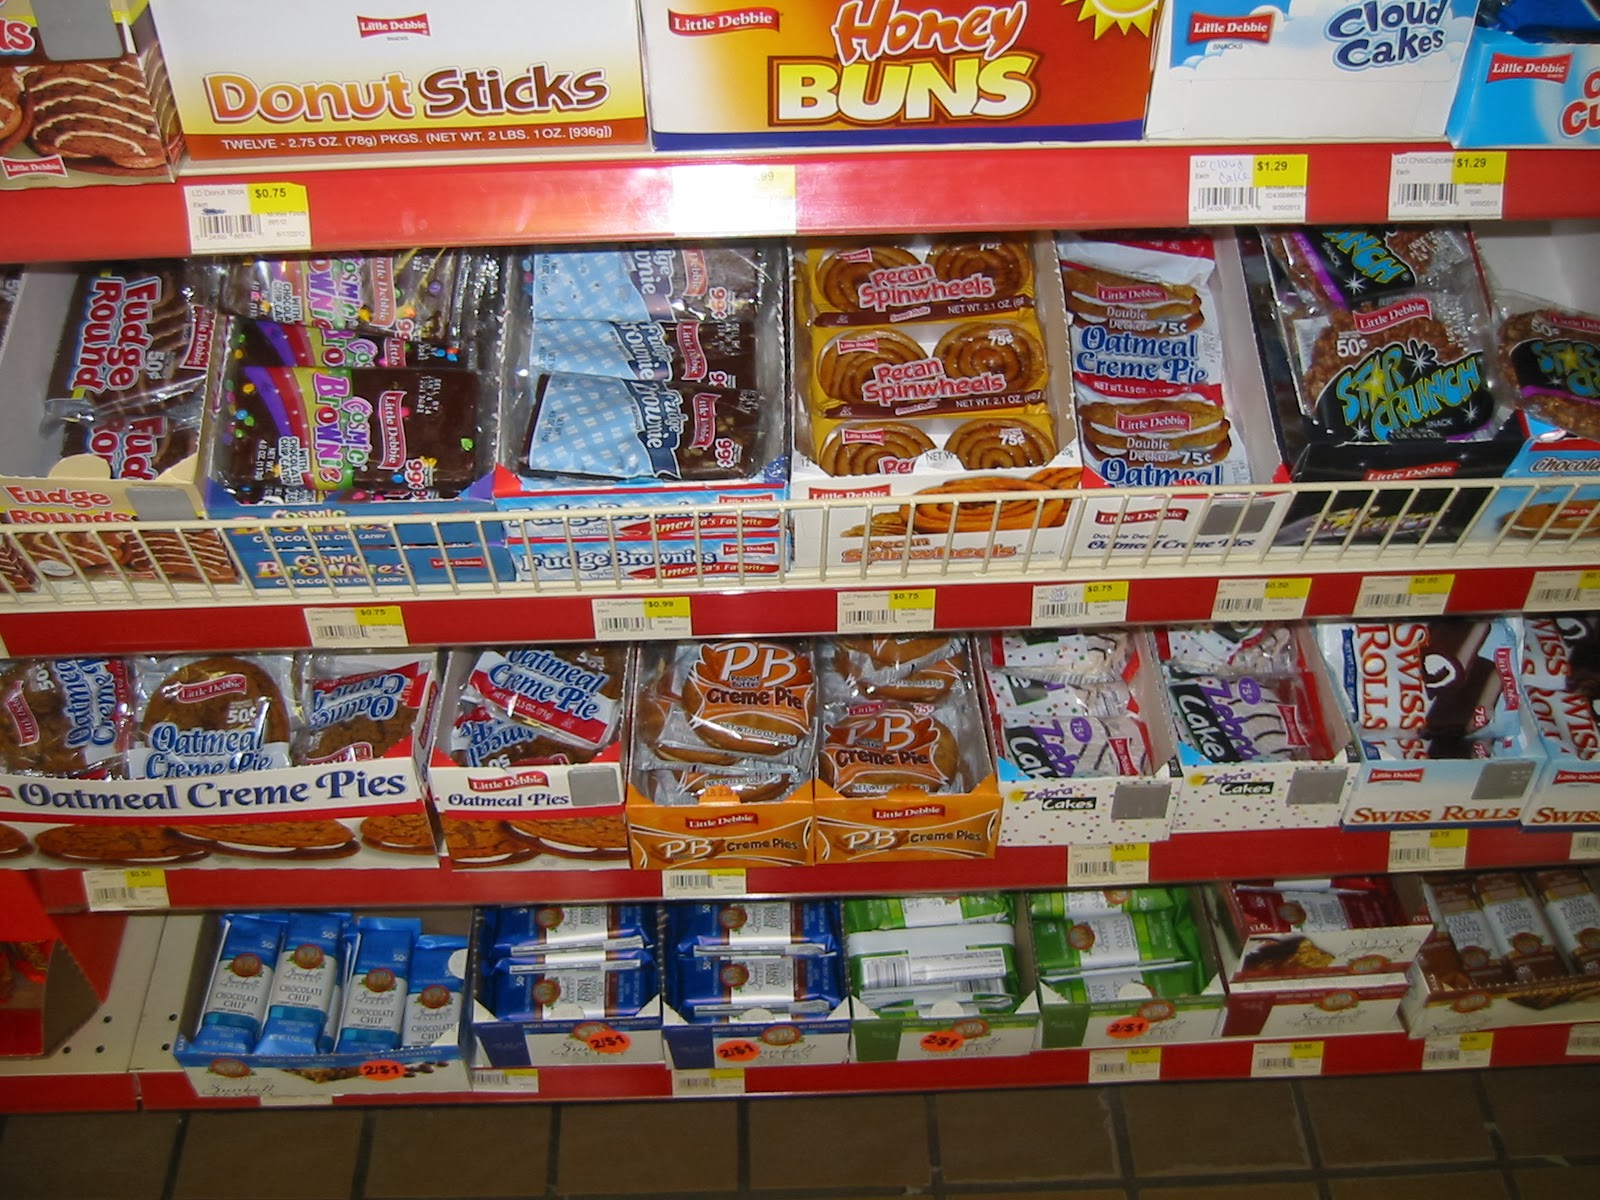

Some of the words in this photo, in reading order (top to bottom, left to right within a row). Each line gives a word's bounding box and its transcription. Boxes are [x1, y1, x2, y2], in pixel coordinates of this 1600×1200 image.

[360, 20, 389, 31] Little
[390, 19, 427, 31] Debbie
[674, 15, 716, 31] Little
[719, 11, 774, 28] Debbie
[1192, 22, 1223, 34] Little
[1226, 21, 1269, 34] Debbie
[1325, 0, 1445, 41] Cloud
[832, 0, 1028, 66] Honey
[1334, 25, 1445, 71] Cakes
[1492, 62, 1529, 75] Little
[1532, 62, 1567, 75] Debbie
[203, 71, 416, 124] Donut
[418, 62, 611, 120] Sticks
[772, 54, 1040, 125] BUNS
[221, 139, 277, 151] TWELVE
[288, 138, 316, 149] 2.75
[318, 137, 342, 148] OZ.
[345, 135, 377, 149] (78g)
[380, 132, 423, 145] PKGS.
[425, 131, 458, 145] (NET
[460, 131, 486, 143] WT.
[488, 130, 497, 141] 2
[500, 129, 531, 141] LBS.
[541, 128, 566, 139] OZ.
[1256, 160, 1288, 172] $1.29
[1456, 157, 1487, 169] $1.29
[255, 187, 287, 200] $0.75
[868, 263, 937, 288] Pecan
[858, 273, 996, 313] Spinwheels
[1101, 290, 1127, 301] Little
[1128, 289, 1163, 299] Debbie
[948, 305, 966, 315] NET
[967, 303, 983, 313] WT.
[1106, 306, 1148, 320] Double
[1358, 312, 1388, 329] Little
[1389, 302, 1426, 320] Debbie
[70, 277, 126, 393] Round
[108, 276, 162, 391] Fudge
[1157, 321, 1188, 335] 75¢
[988, 334, 1014, 347] 75¢
[1081, 326, 1199, 359] Oatmeal
[1335, 337, 1368, 359] 50¢
[873, 357, 944, 384] Pecan
[1074, 351, 1160, 381] Creme
[1162, 358, 1208, 384] Pie
[861, 373, 1008, 407] Spinwheels
[1371, 355, 1483, 442] CRUNCH
[381, 395, 396, 426] Little
[955, 399, 974, 409] NET
[975, 398, 992, 408] WT.
[993, 396, 1006, 406] 2.1
[1007, 395, 1023, 405] OZ.
[1119, 418, 1149, 430] Little
[1150, 415, 1186, 427] Debbie
[385, 426, 399, 465] Debbie
[844, 432, 860, 441] Little
[861, 431, 883, 441] Debbie
[999, 433, 1027, 447] 75¢
[1126, 437, 1170, 450] Double
[714, 437, 735, 469] 99¢
[1128, 450, 1171, 463] Decker
[1179, 450, 1213, 466] 75¢
[404, 458, 425, 490] 99¢
[1099, 457, 1224, 486] Oatmeal
[1367, 471, 1402, 481] Little
[1404, 465, 1452, 479] Debbie
[5, 484, 113, 510] Fudge
[893, 592, 919, 600] $0.75
[1087, 584, 1113, 593] $0.75
[648, 600, 674, 608] $0.99
[506, 650, 608, 694] Oatmeal
[715, 641, 797, 688] PB
[1355, 624, 1391, 730] ROLLS
[1391, 623, 1430, 731] SWISS
[489, 662, 554, 703] Creme
[557, 685, 599, 720] Pie
[706, 687, 770, 705] Creme
[774, 686, 803, 710] Pie
[227, 705, 258, 724] 50¢
[847, 714, 917, 750] PB
[1178, 694, 1226, 758] Cake
[151, 721, 265, 757] Oatmeal
[145, 753, 227, 779] Creme
[835, 749, 896, 768] Creme
[898, 750, 930, 766] Pie
[471, 779, 503, 791] Little
[504, 773, 544, 788] Debbie
[1203, 772, 1252, 786] Zebra
[1220, 782, 1271, 795] Cakes
[19, 781, 183, 810] Oatmeal
[187, 779, 310, 809] Creme
[316, 769, 408, 800] Pies
[1022, 786, 1073, 802] Zebra
[447, 793, 524, 808] Oatmeal
[526, 793, 570, 807] Pies
[1043, 799, 1095, 810] Cakes
[688, 818, 717, 829] Little
[717, 815, 754, 827] Debbie
[875, 809, 900, 820] Little
[900, 805, 942, 818] Debbie
[658, 838, 716, 859] PB
[726, 840, 771, 853] Creme
[772, 838, 798, 852] Pies
[843, 829, 898, 850] PB
[910, 831, 955, 844] Creme
[956, 830, 982, 843] Pies
[215, 991, 259, 1004] CHOCOLATE
[279, 984, 323, 996] CHOCOLATE
[287, 993, 312, 1003] CHIP
[223, 1000, 248, 1010] CHIP
[351, 1007, 395, 1018] CHOCOLATE
[360, 1016, 384, 1025] CHIP
